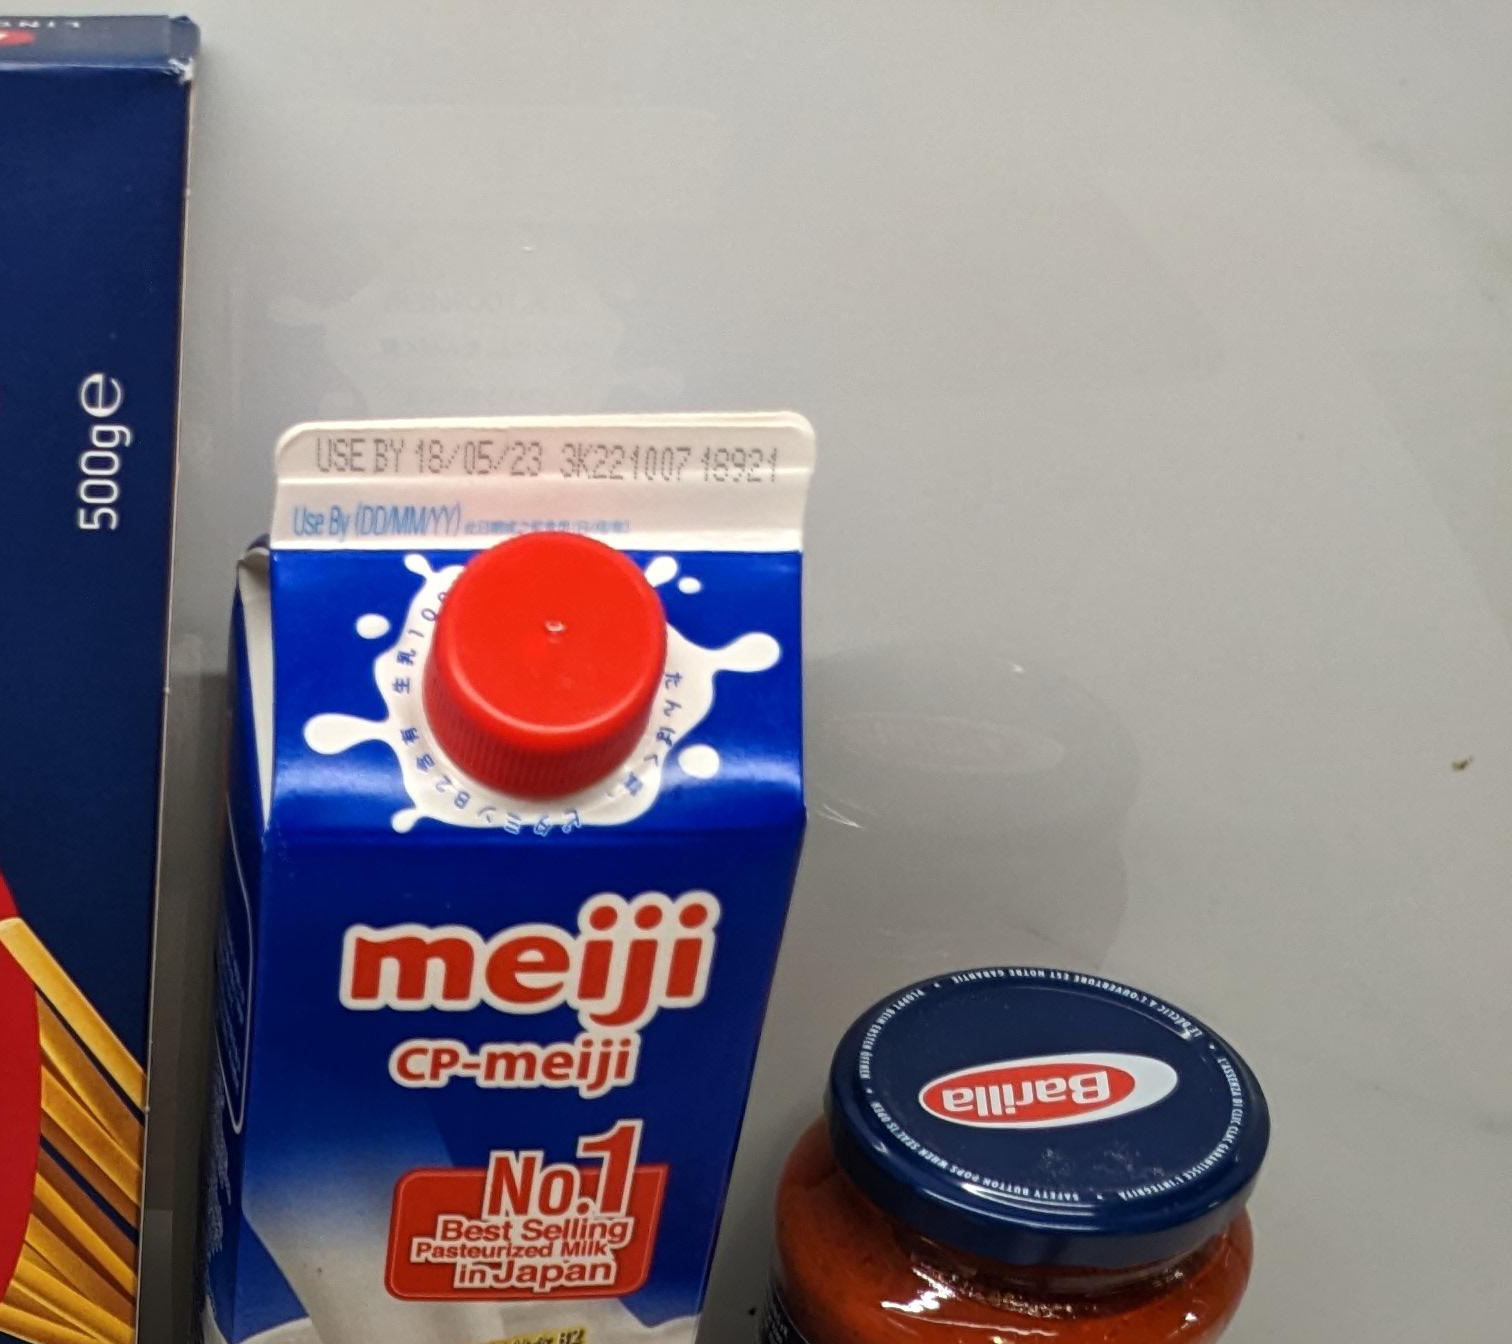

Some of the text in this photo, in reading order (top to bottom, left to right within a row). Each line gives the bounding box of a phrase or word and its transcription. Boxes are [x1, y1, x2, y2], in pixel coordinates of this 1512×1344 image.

[315, 436, 366, 474] USE
[372, 437, 405, 476] BY
[414, 439, 544, 478] 18/05/23
[700, 445, 779, 483] 18921
[293, 506, 325, 535] Use
[330, 507, 350, 536] By
[354, 501, 462, 536] (DD/MM/YY)
[344, 896, 716, 1030] meiji
[1008, 968, 1046, 979] NOTRE
[1049, 970, 1071, 982] EST
[393, 1036, 634, 1092] CP-meiji
[941, 1070, 1113, 1119] Barilla
[486, 1122, 638, 1218] No.1
[918, 1147, 949, 1170] WHEN
[949, 1164, 981, 1184] POPS
[982, 1176, 1030, 1197] BUTTON
[1034, 1188, 1080, 1202] SAFETY
[439, 1217, 631, 1248] Best Selling
[415, 1240, 609, 1260] Pasteurized Milk
[458, 1259, 612, 1290] in Japan
